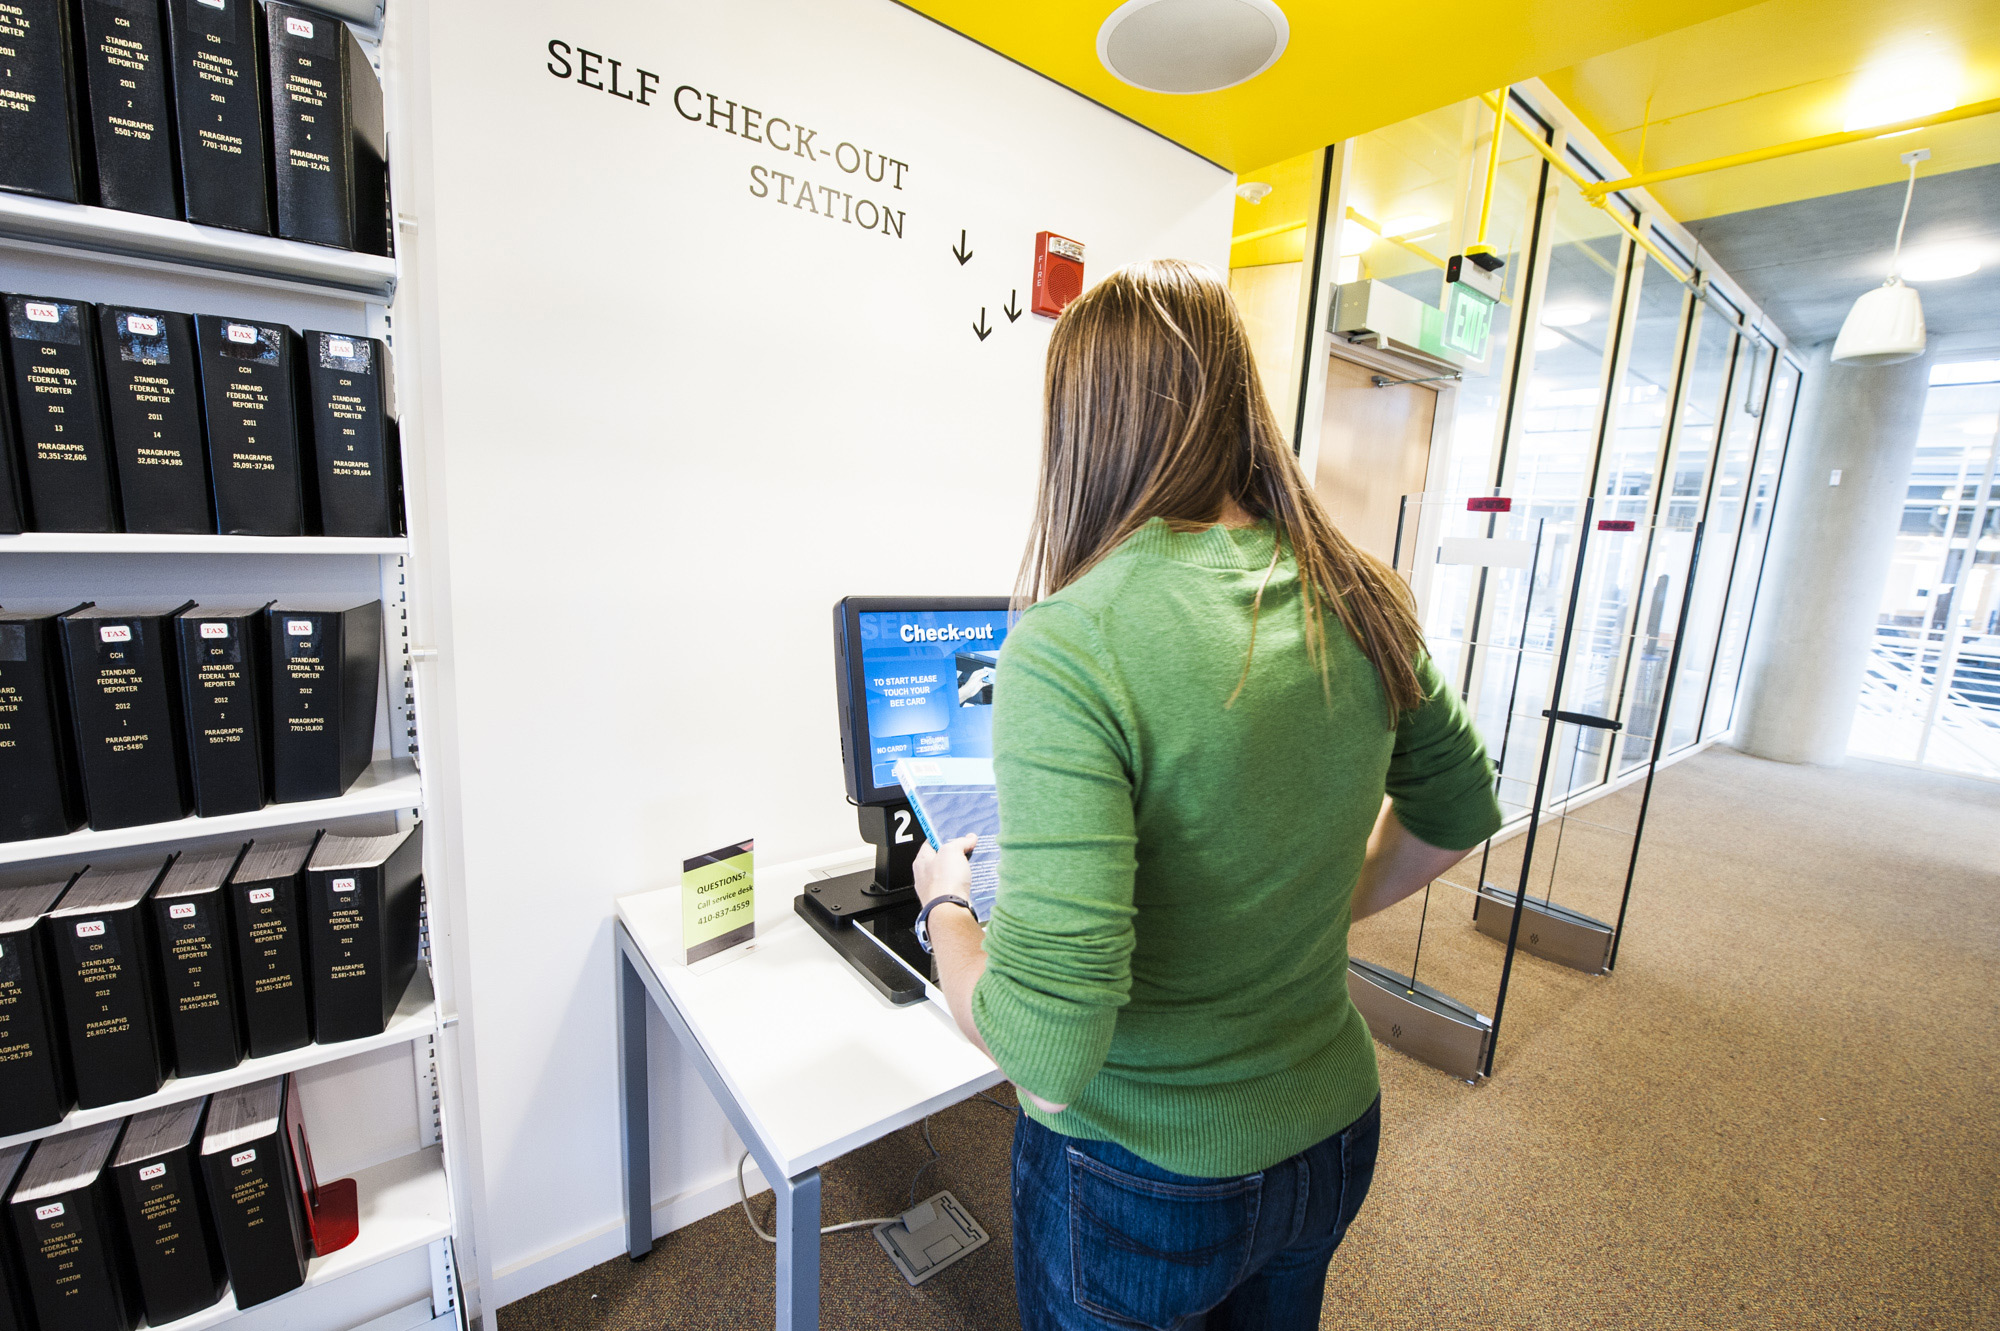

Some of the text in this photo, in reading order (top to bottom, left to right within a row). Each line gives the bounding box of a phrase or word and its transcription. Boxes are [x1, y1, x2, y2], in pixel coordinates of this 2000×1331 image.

[114, 17, 130, 28] CCH
[290, 22, 310, 34] TAX
[105, 35, 143, 50] STANDARD
[206, 33, 221, 44] CCH
[100, 44, 149, 62] FEDERAL TAX
[107, 56, 144, 71] REPORTER
[197, 51, 233, 66] STANDARD
[298, 58, 312, 67] CCH
[192, 59, 239, 78] FEDERAL TAX
[199, 71, 234, 86] REPORTER
[290, 74, 322, 88] STANDARD
[120, 79, 136, 89] 2011
[285, 83, 327, 99] FEDERAL TAX
[210, 93, 226, 104] 2011
[291, 93, 323, 107] REPORTER
[127, 100, 133, 108] 2
[217, 114, 223, 122] 3
[300, 114, 315, 123] 2011
[547, 39, 909, 191] SELF CHECK-OUT
[108, 116, 154, 131] PARAGRAPHS
[114, 126, 151, 140] 5501-7650
[199, 129, 243, 145] PARAGRAPHS
[202, 139, 242, 154] 7701-10,800
[289, 148, 329, 163] PARAGRAPHS
[749, 165, 906, 239] STATION
[30, 308, 54, 317] TAX
[132, 321, 153, 331] TAX
[1451, 292, 1487, 354] EXIT
[232, 330, 252, 339] TAX
[41, 347, 57, 356] CCH
[142, 358, 157, 367] CCH
[32, 366, 70, 376] STANDARD
[238, 366, 252, 374] CCH
[27, 375, 77, 386] FEDERAL TAX
[134, 375, 169, 385] STANDARD
[35, 385, 72, 395] REPORTER
[129, 384, 175, 395] FEDERAL TAX
[230, 383, 263, 392] STANDARD
[136, 394, 170, 403] REPORTER
[226, 391, 254, 401] FEDERAL
[332, 395, 361, 404] STANDARD
[48, 405, 65, 413] 2011
[232, 401, 264, 410] REPORTER
[328, 402, 353, 411] FEDERAL
[147, 413, 163, 421] 2011
[333, 411, 362, 420] REPORTER
[54, 424, 63, 432] 13
[243, 419, 257, 427] 2011
[342, 428, 355, 436] 2011
[248, 436, 255, 444] 15
[37, 442, 85, 452] PARAGRAPHS
[137, 448, 181, 457] PARAGRAPHS
[233, 453, 273, 462] PARAGRAPHS
[333, 460, 369, 468] PARAGRAPHS
[105, 630, 127, 638] TAX
[900, 623, 994, 642] Check-out
[100, 668, 136, 677] STANDARD
[202, 664, 234, 672] STANDARD
[204, 680, 236, 688] REPORTER
[874, 675, 938, 686] TO START PLEASE
[103, 685, 138, 694] REPORTER
[883, 686, 930, 697] TOUCH YOUR
[115, 702, 131, 710] 2012
[890, 697, 926, 707] BEE CARD
[204, 727, 244, 736] PARAGRAPHS
[105, 734, 149, 744] PARAGRAPHS
[113, 743, 144, 752] 621-5480
[877, 744, 907, 754] NO CARD?
[894, 809, 913, 844] 2
[697, 871, 747, 894] QUESTIONS?
[697, 884, 753, 910] Call service desk
[332, 909, 359, 917] STANDARD
[697, 900, 750, 925] 410-837-4559
[80, 925, 101, 933] TAX
[333, 923, 359, 931] REPORTER
[81, 957, 115, 968] STANDARD
[331, 963, 364, 972] PARAGRAPHS
[77, 967, 107, 976] FEDERAL
[84, 973, 117, 983] REPORTER
[95, 989, 110, 997] 2012
[86, 1016, 128, 1029] PARAGRAPHS
[143, 1166, 163, 1176] TAX
[150, 1183, 163, 1191] CCH
[144, 1193, 175, 1207] STANDARD
[141, 1198, 181, 1215] FEDERAL TAX
[147, 1206, 177, 1220] REPORTER
[158, 1222, 172, 1231] 2012
[155, 1233, 179, 1245] CITATOR
